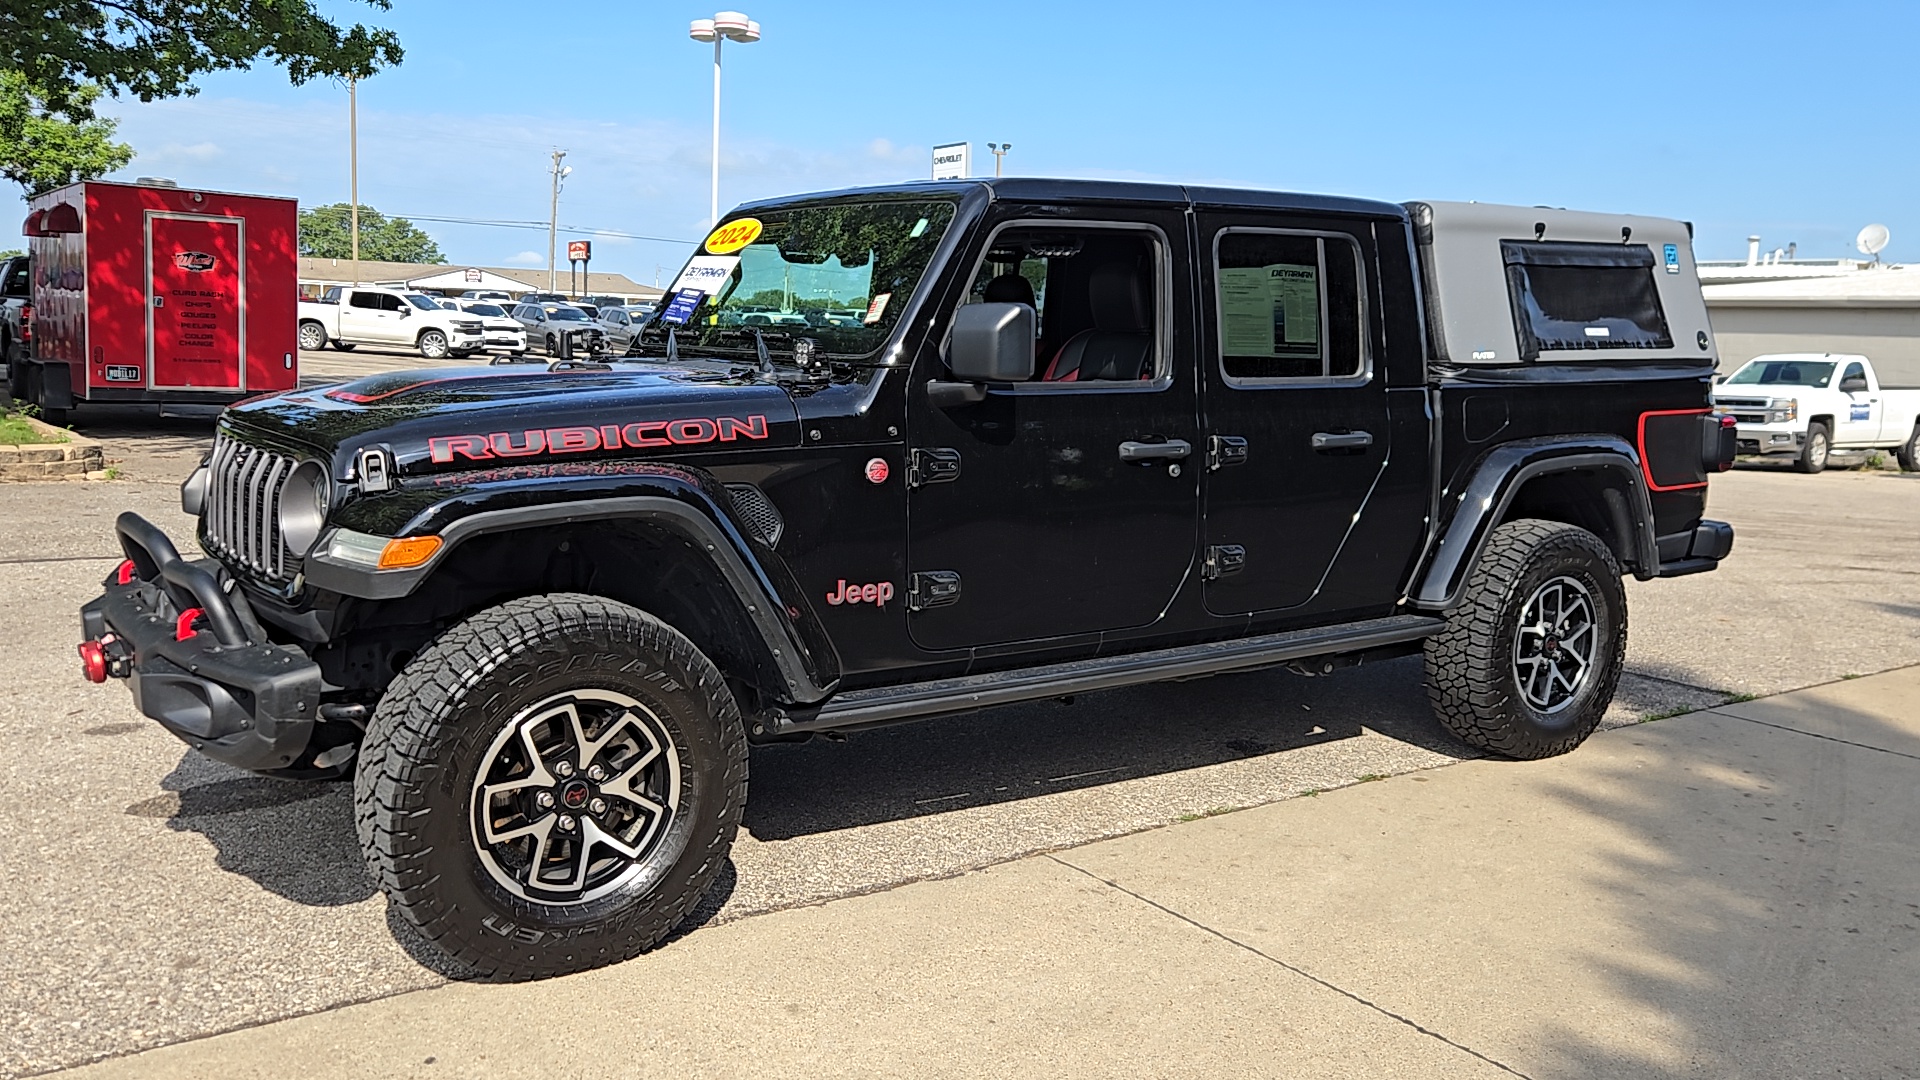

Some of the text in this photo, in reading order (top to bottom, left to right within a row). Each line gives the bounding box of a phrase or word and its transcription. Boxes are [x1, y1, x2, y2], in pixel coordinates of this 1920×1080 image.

[709, 226, 758, 246] 2024
[1271, 269, 1313, 279] DEYARMAN
[172, 289, 224, 298] CURB RASH
[180, 311, 217, 319] GOUGES
[180, 322, 217, 330] PEELING
[428, 415, 769, 464] RUBICON
[826, 579, 895, 607] Jeep
[619, 658, 684, 693] A/T
